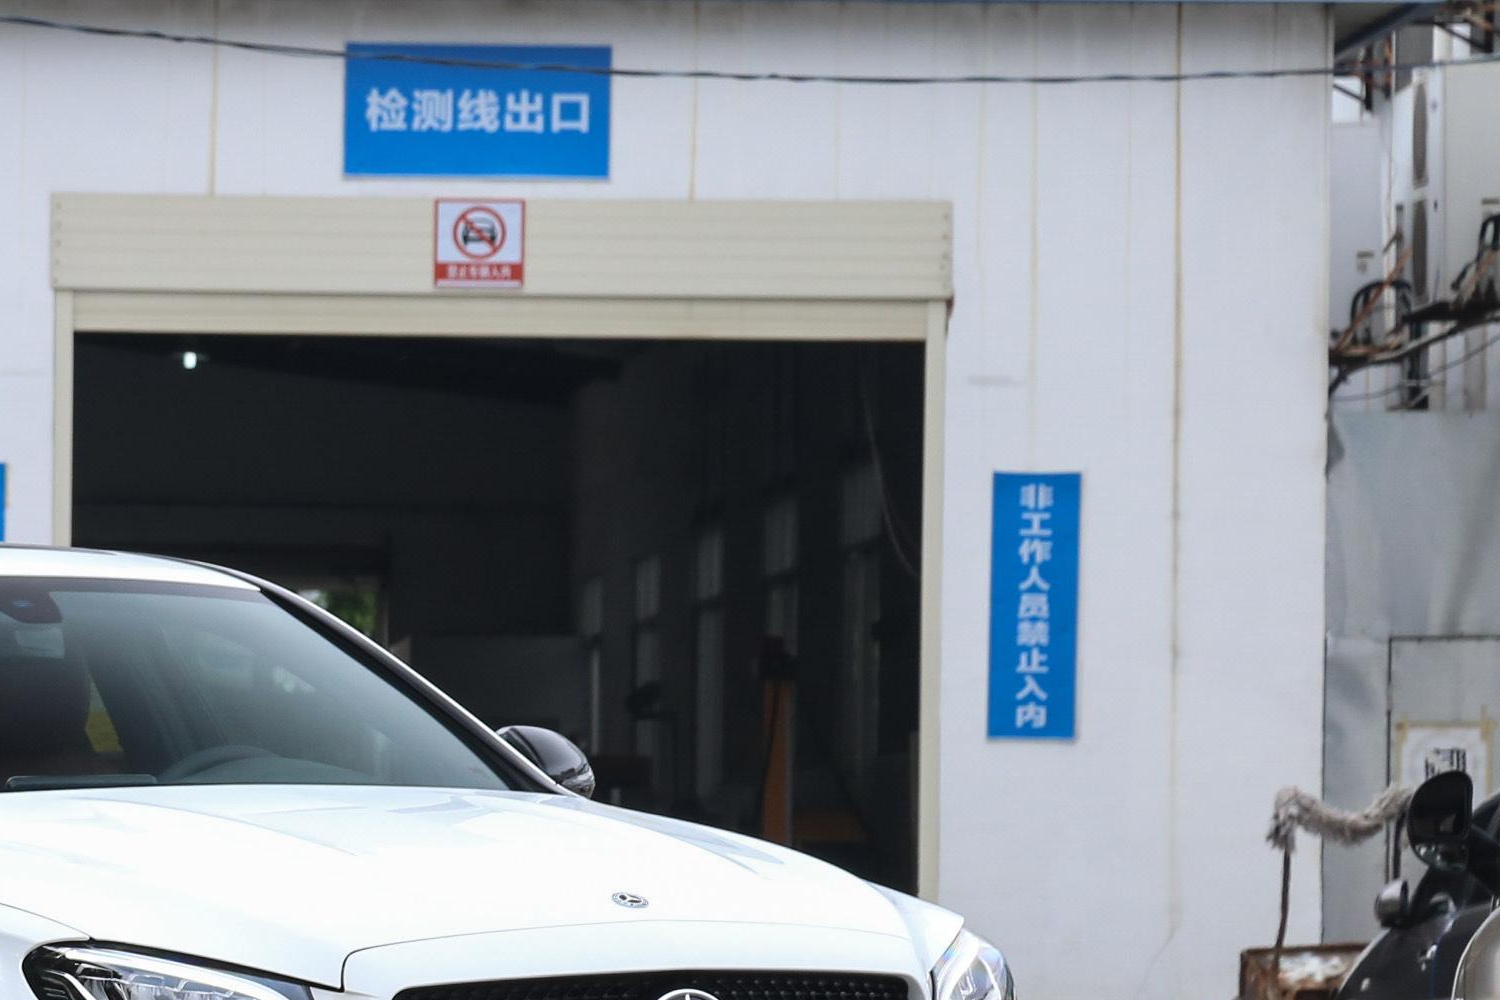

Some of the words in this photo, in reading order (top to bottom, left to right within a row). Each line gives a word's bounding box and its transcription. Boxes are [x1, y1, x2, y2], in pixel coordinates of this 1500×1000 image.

[366, 87, 590, 134] 检测线出口
[1016, 483, 1054, 729] 非工作人员禁止入内
